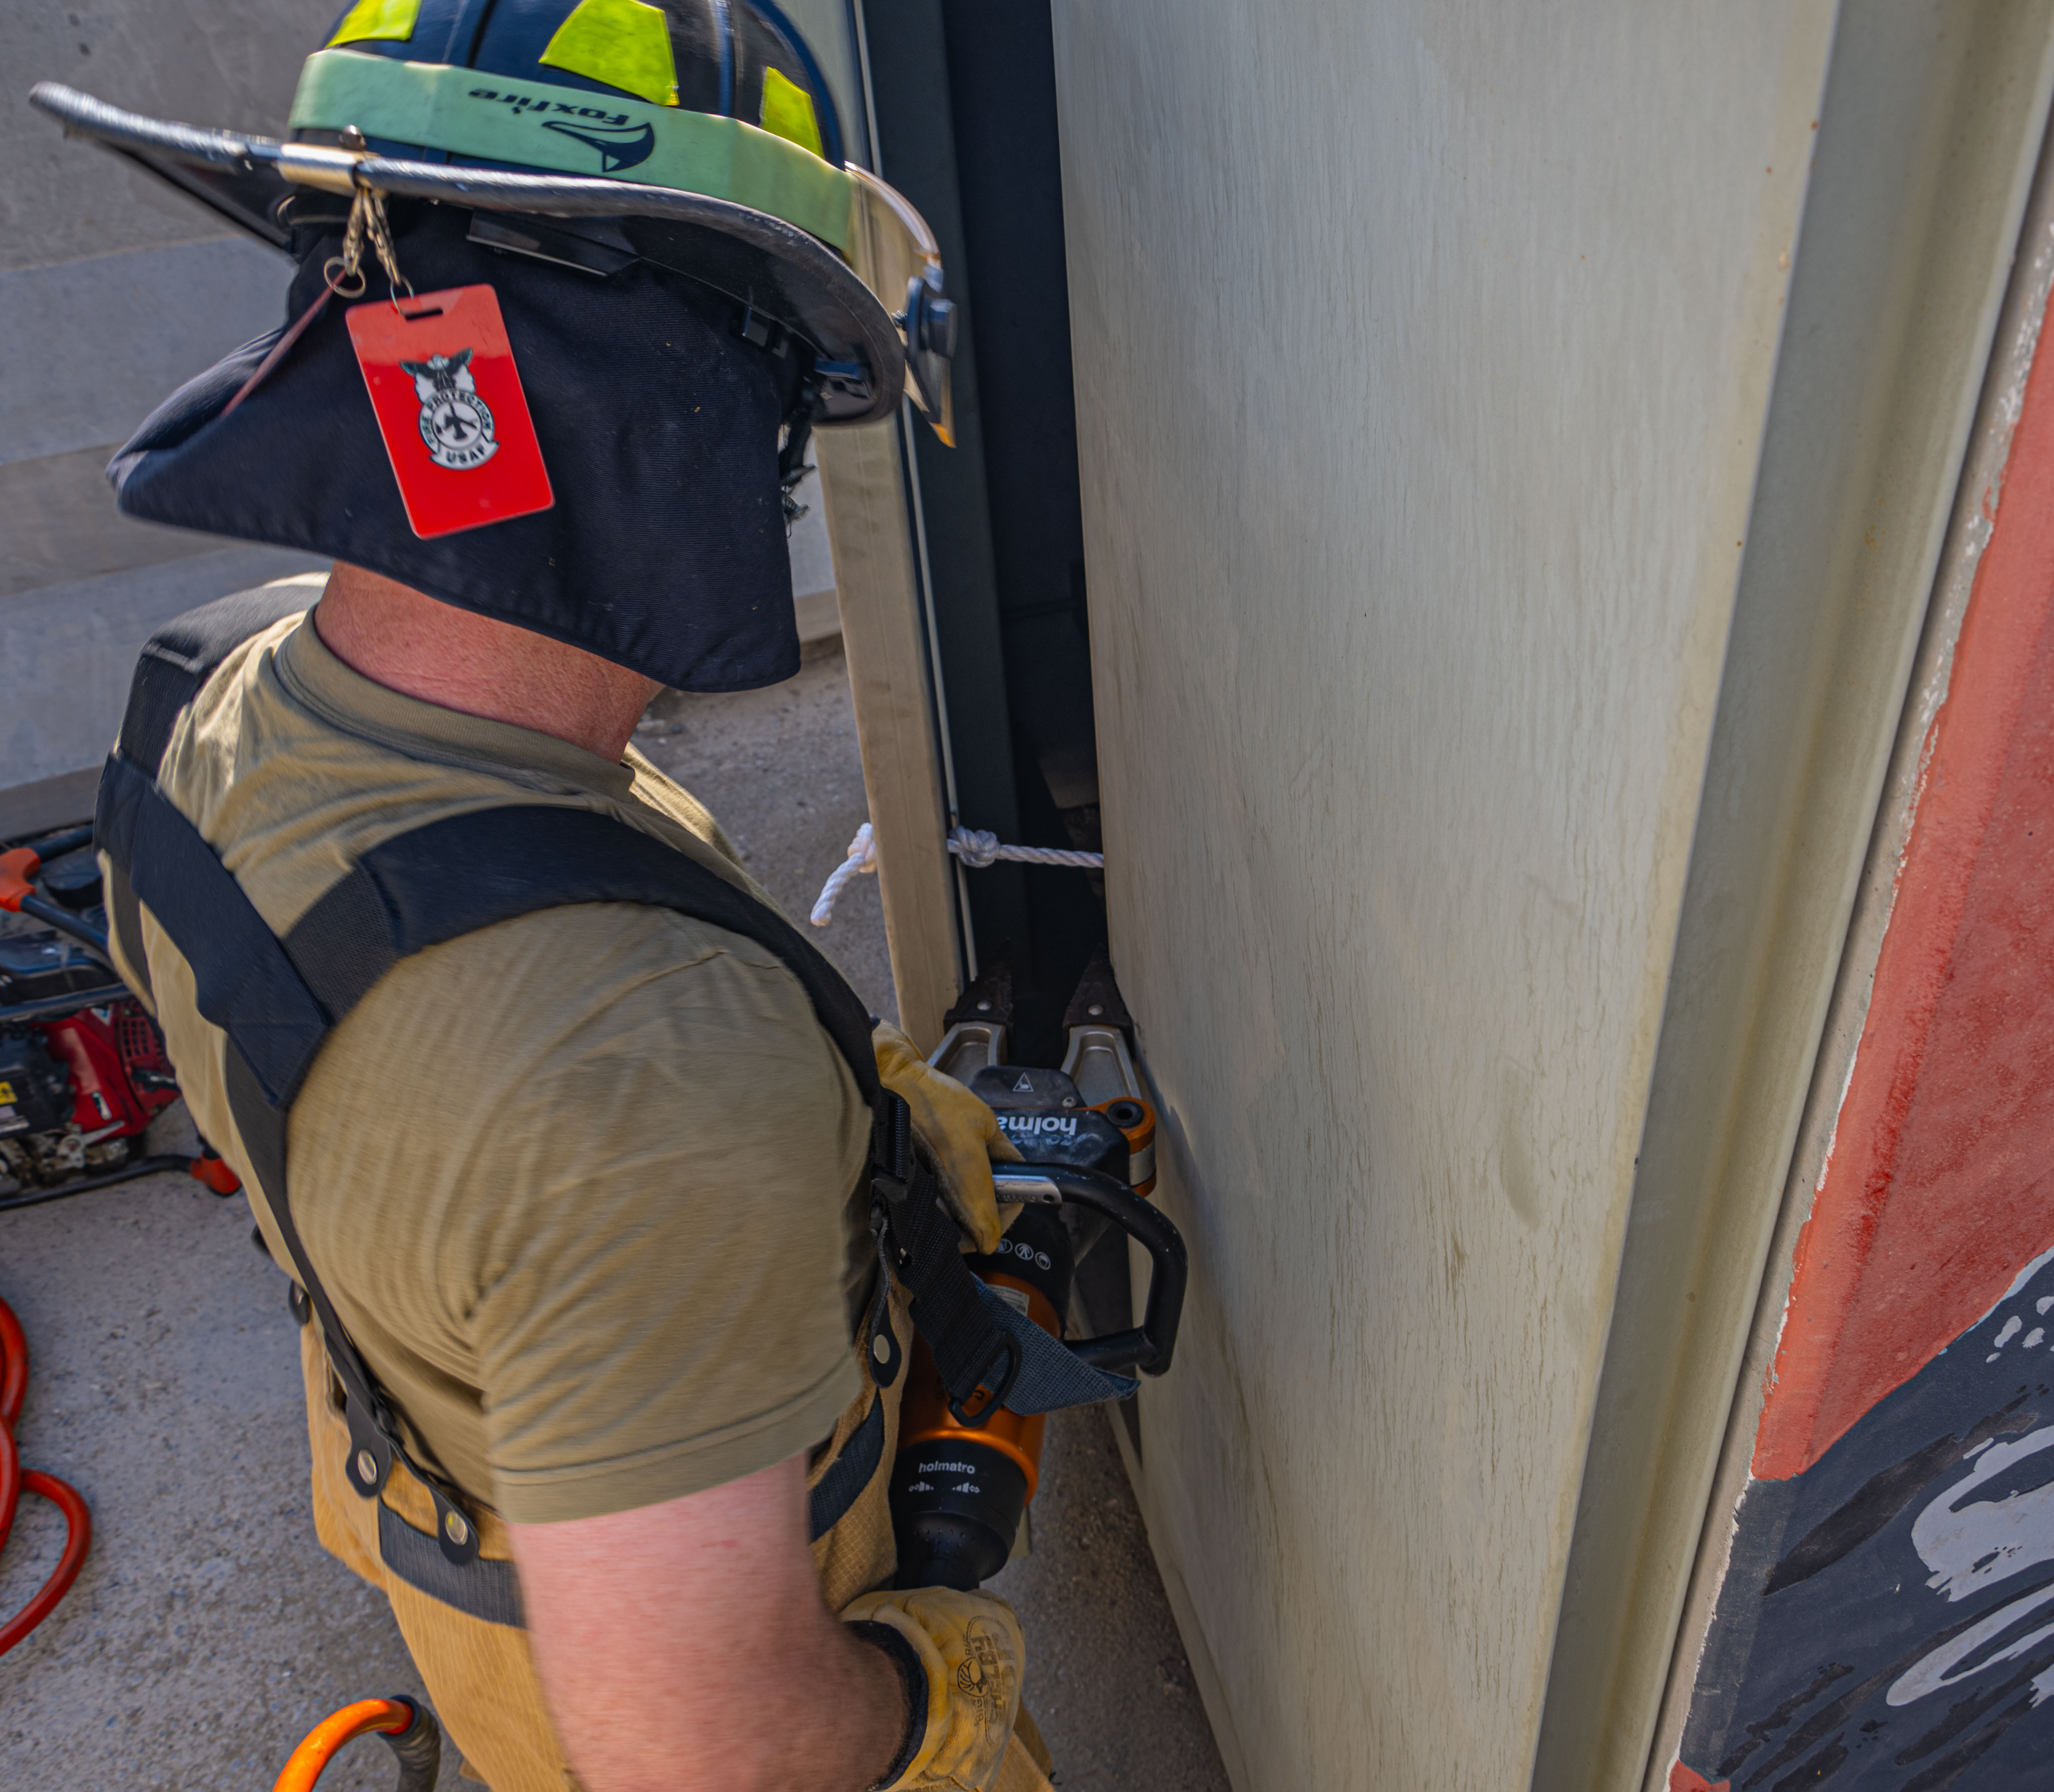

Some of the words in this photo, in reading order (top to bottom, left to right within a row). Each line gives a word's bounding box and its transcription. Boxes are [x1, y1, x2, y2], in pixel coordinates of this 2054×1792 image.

[427, 390, 492, 430] PROTECTION
[445, 443, 485, 464] USAF
[996, 1116, 1077, 1135] holma
[918, 1460, 975, 1474] holmatro
